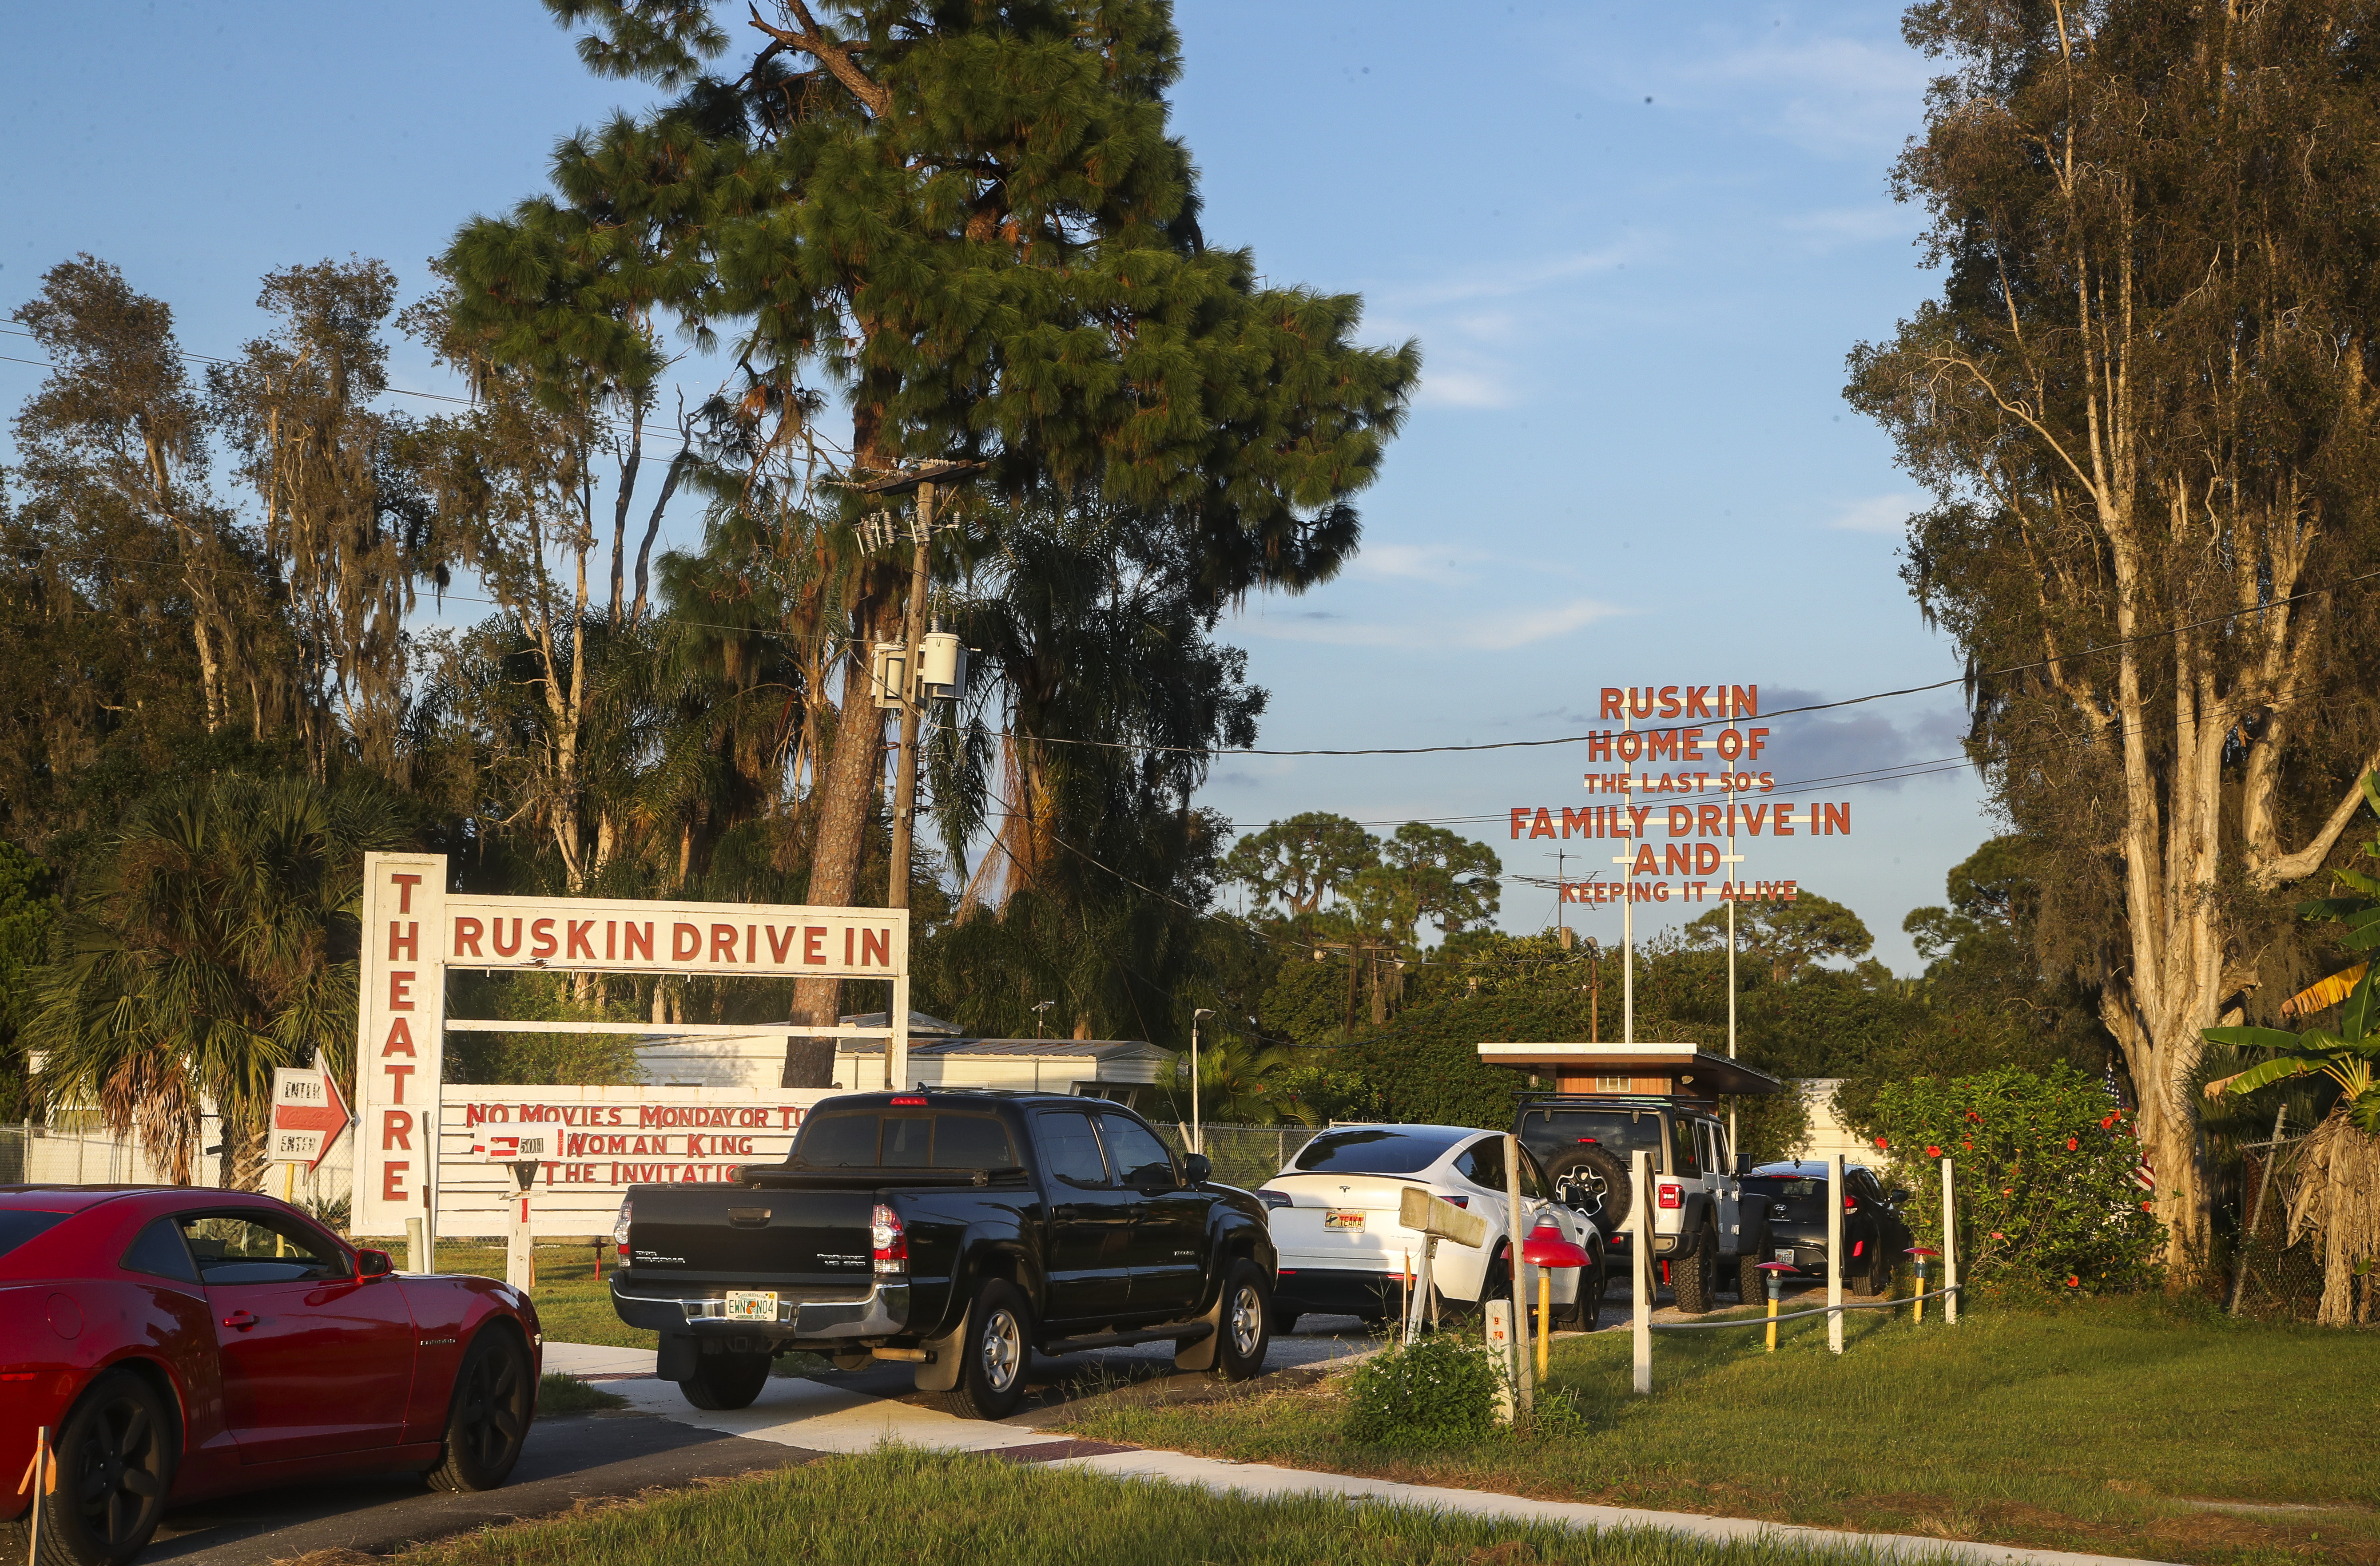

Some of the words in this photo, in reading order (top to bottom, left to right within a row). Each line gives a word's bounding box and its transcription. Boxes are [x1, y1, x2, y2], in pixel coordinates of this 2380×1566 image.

[1600, 684, 1757, 719] RUSKIN
[1588, 729, 1703, 762] HOME
[1716, 728, 1770, 761] OF
[1584, 773, 1631, 794] THE
[1642, 772, 1710, 793] LAST
[1720, 771, 1774, 793] 50'S
[1510, 806, 1652, 840] FAMILY
[1668, 803, 1795, 837] DRIVE
[1811, 802, 1851, 836] IN
[1631, 843, 1721, 876] AND
[1560, 882, 1669, 903] KEEPING
[1683, 881, 1708, 902] IT
[1719, 880, 1798, 902] ALIVE
[454, 917, 655, 960] RUSKIN
[672, 922, 828, 966] DRIVE
[845, 927, 891, 967] IN
[382, 873, 422, 1201] THEATRE
[285, 1082, 321, 1099] ENTER
[466, 1103, 509, 1128] NO
[519, 1103, 623, 1127] MOVIES
[639, 1105, 737, 1130] MONDAY
[280, 1135, 316, 1153] ENTER
[521, 1138, 544, 1154] 5011
[567, 1133, 667, 1158] WOMAN
[687, 1133, 753, 1158] KING
[540, 1161, 596, 1186] THE
[1339, 1216, 1362, 1227] TEAKA
